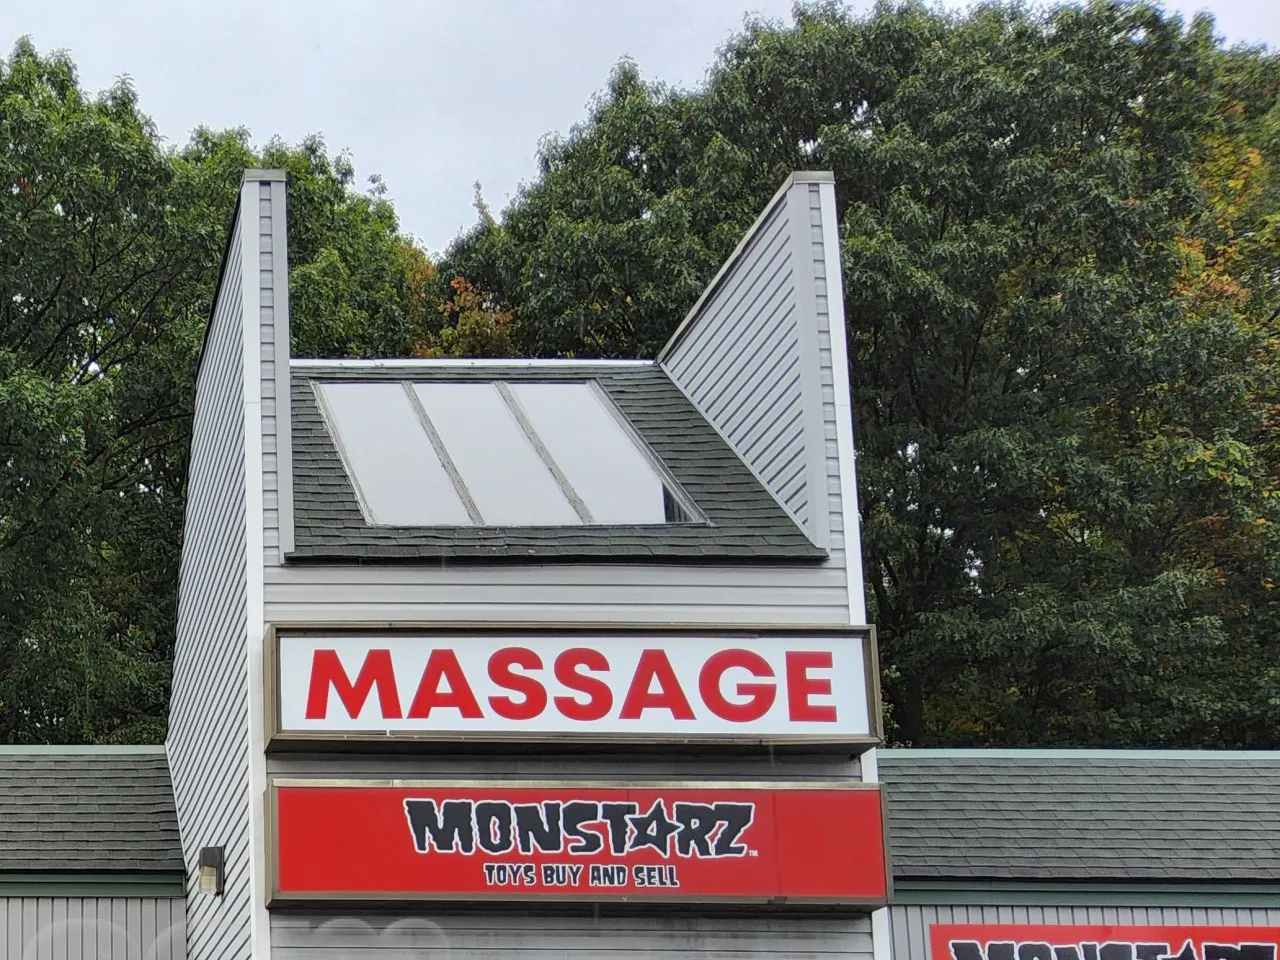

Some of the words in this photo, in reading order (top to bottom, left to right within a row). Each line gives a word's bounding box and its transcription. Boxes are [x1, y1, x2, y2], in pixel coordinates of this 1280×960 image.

[305, 647, 837, 722] MASSAGE
[483, 863, 535, 886] TOYS
[541, 863, 584, 886] BUY
[588, 864, 627, 887] AND
[634, 864, 680, 888] SELL
